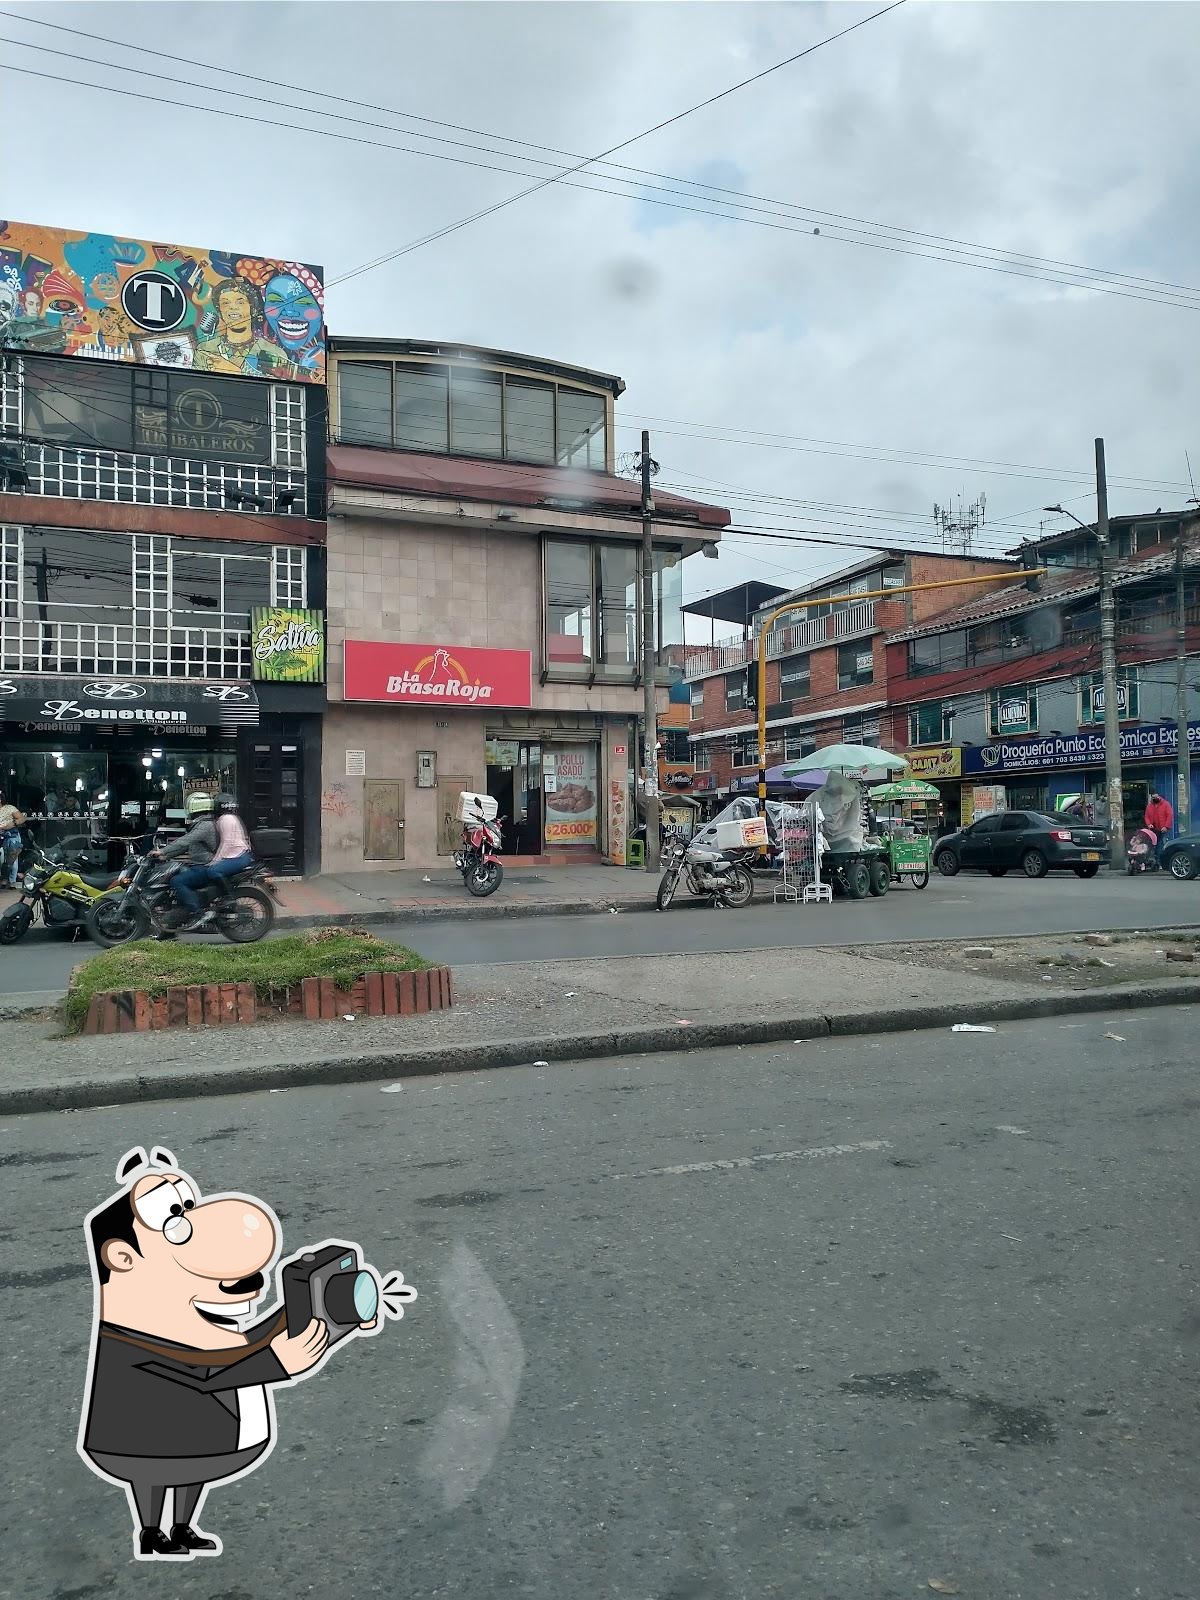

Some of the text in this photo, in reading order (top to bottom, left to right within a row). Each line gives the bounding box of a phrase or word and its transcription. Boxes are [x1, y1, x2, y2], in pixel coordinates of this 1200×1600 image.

[133, 279, 176, 322] T
[185, 399, 213, 426] T
[255, 620, 323, 660] Sativa
[402, 670, 420, 682] La
[1002, 726, 1200, 760] Droguería Punto Ecoómica Expes
[557, 765, 583, 776] ASADO
